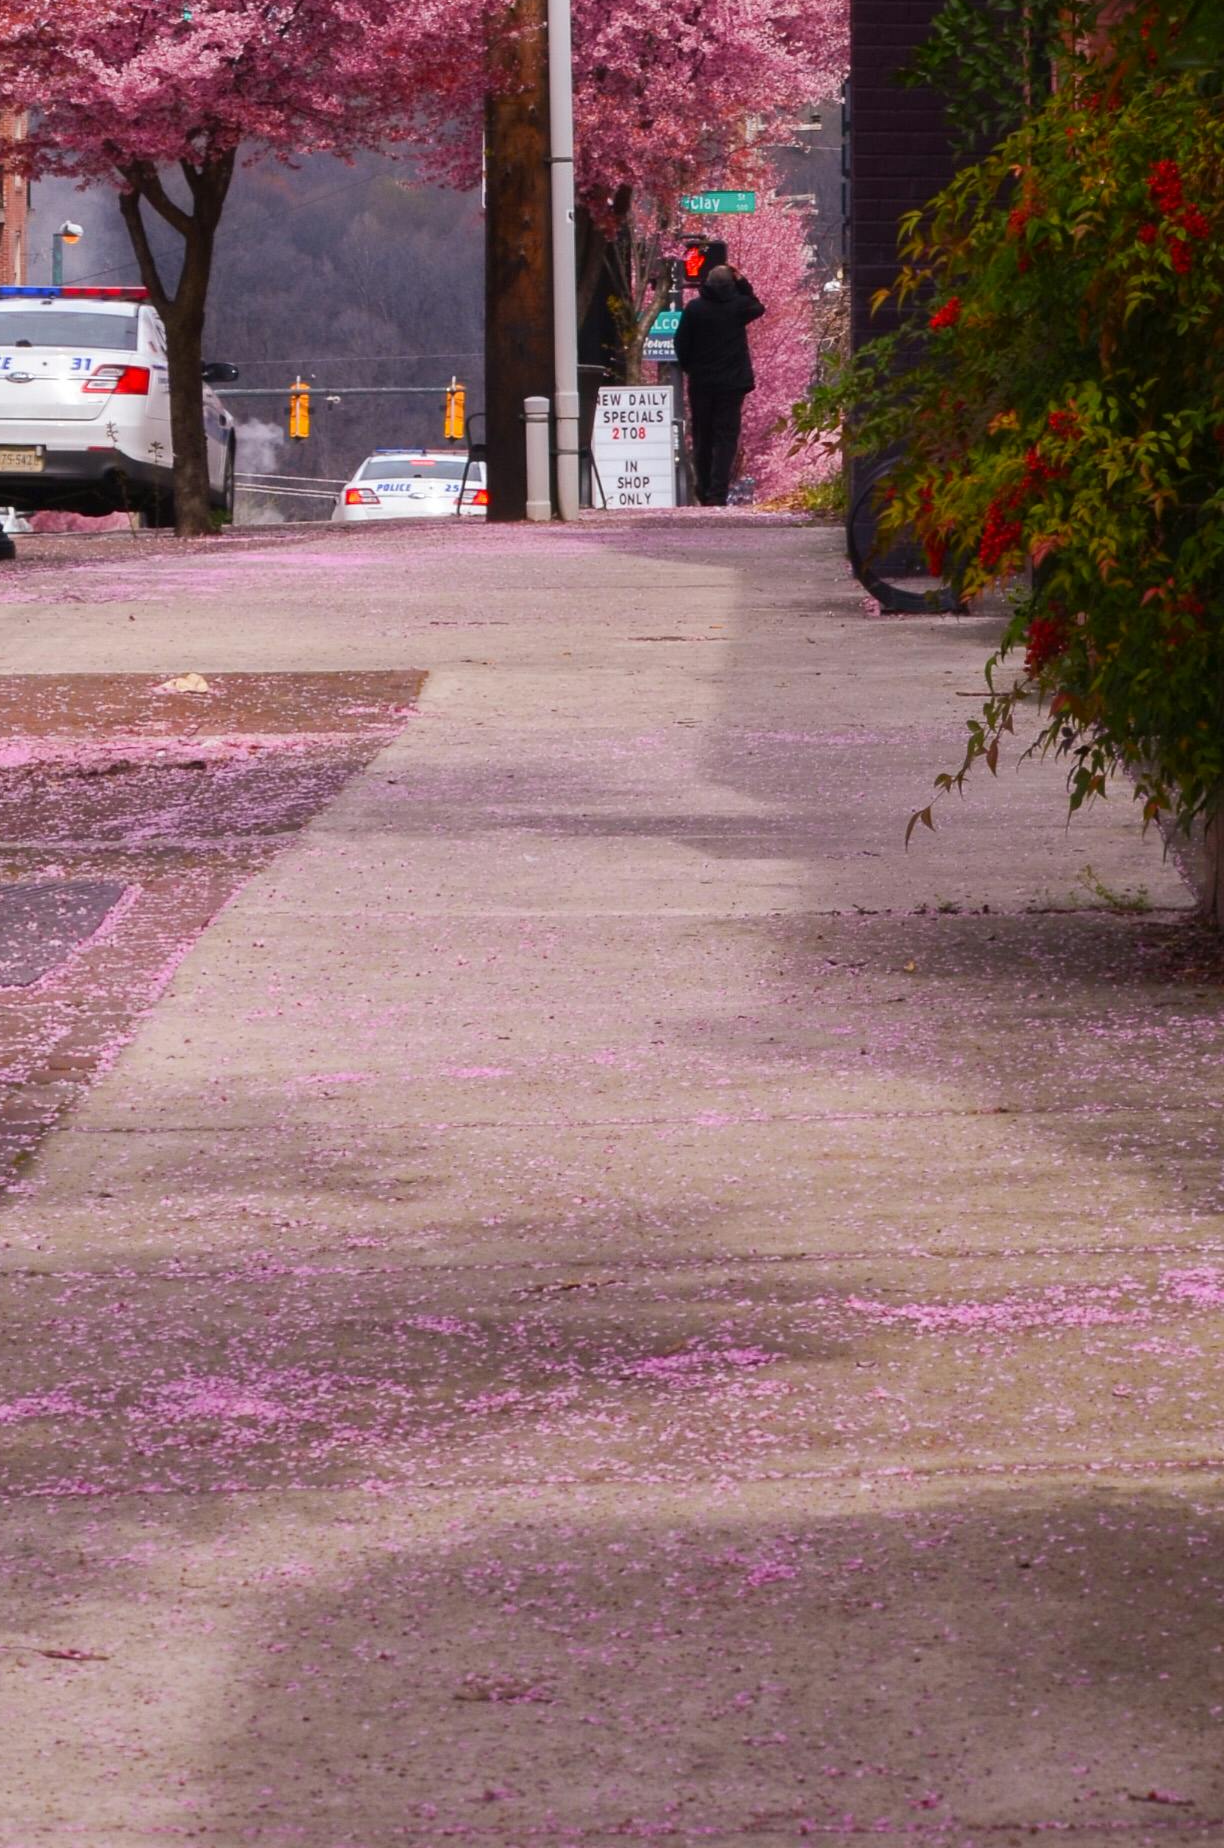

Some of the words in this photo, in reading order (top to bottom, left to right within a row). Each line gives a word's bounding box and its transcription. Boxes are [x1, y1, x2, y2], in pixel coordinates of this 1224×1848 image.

[690, 196, 720, 212] Clay
[70, 357, 92, 371] 31
[628, 393, 667, 406] DAILY
[603, 410, 664, 424] SPECIALS
[625, 460, 638, 473] IN
[376, 483, 411, 492] POLICE
[445, 484, 460, 493] 25
[617, 476, 650, 489] SHOP
[619, 492, 652, 506] ONLY
